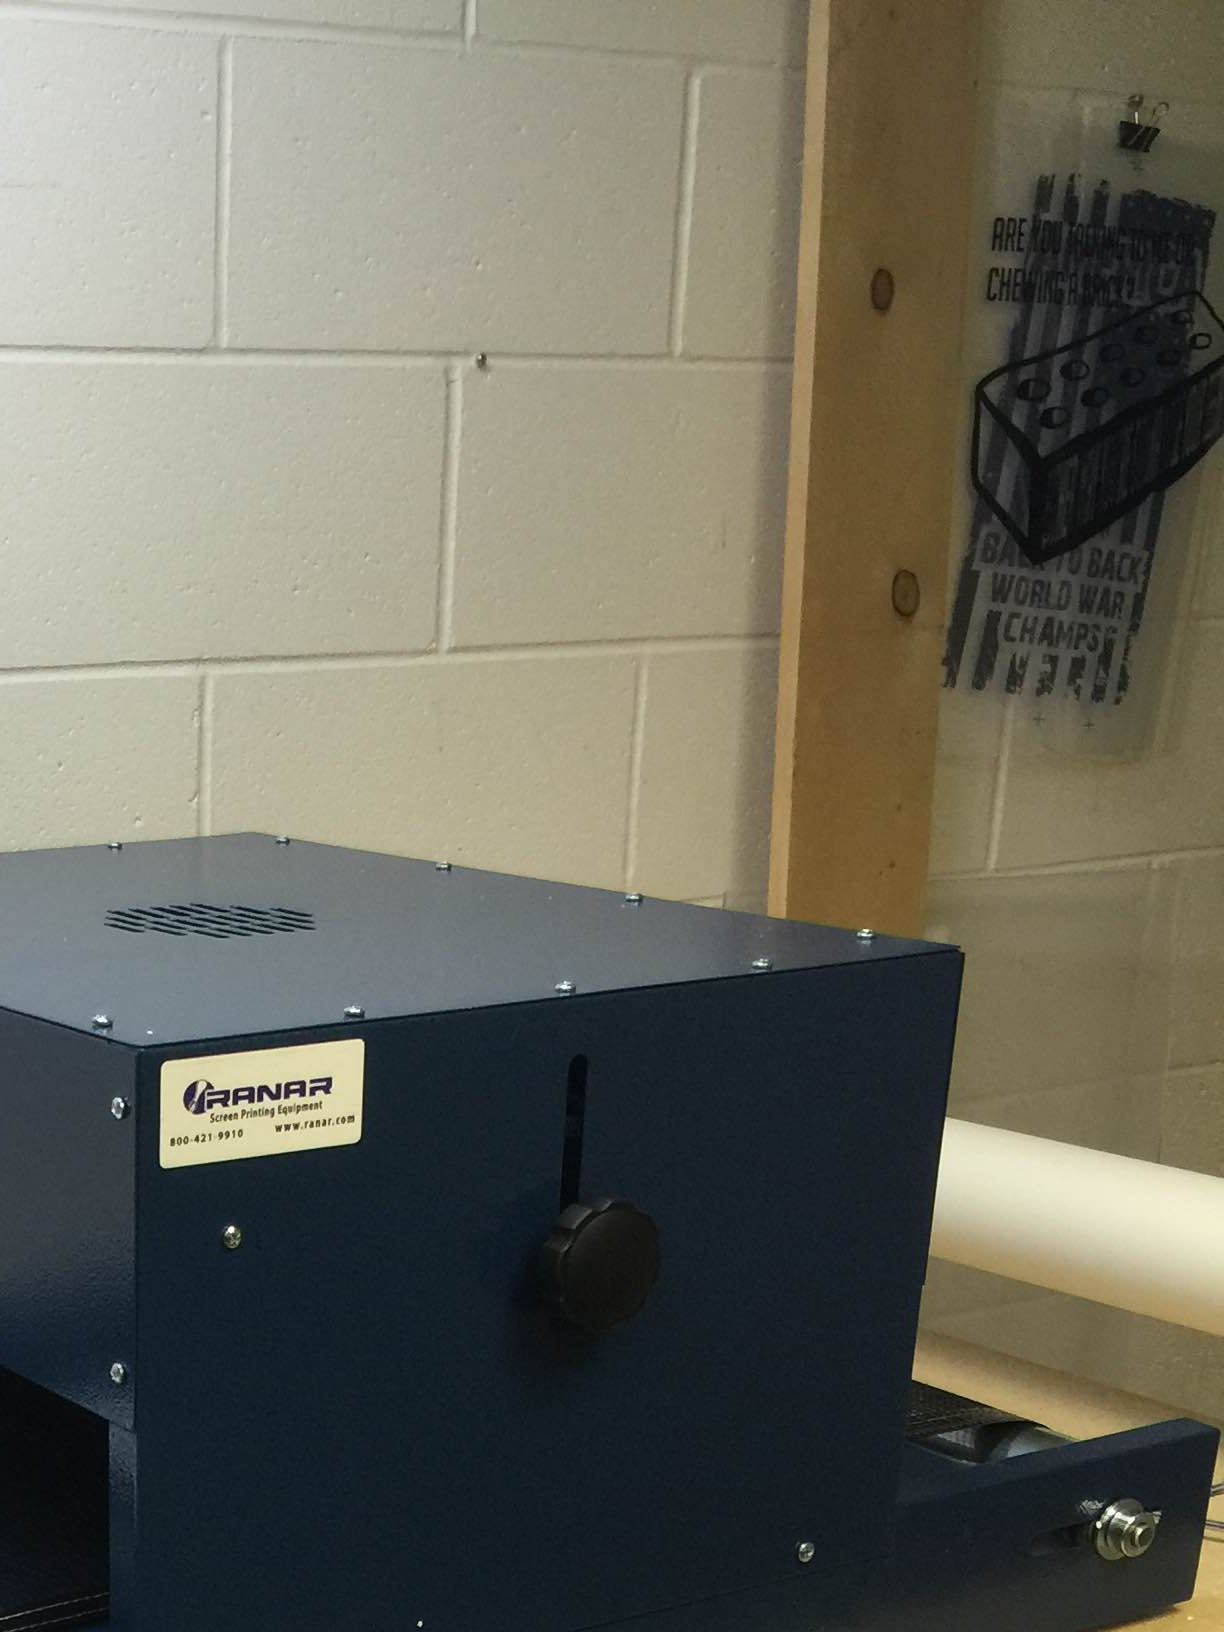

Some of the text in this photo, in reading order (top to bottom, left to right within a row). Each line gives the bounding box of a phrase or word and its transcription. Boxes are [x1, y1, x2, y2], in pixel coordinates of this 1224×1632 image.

[991, 217, 1027, 252] ARE
[1031, 218, 1064, 254] YOU
[986, 267, 1064, 302] CHEWING
[1087, 547, 1142, 584] BACK
[991, 572, 1125, 619] WORLD WAR
[1002, 611, 1100, 653] CHAMPS
[204, 1076, 333, 1110] RANAR
[209, 1100, 323, 1123] Screen Printing Equipment
[274, 1113, 356, 1133] www.ranar.com
